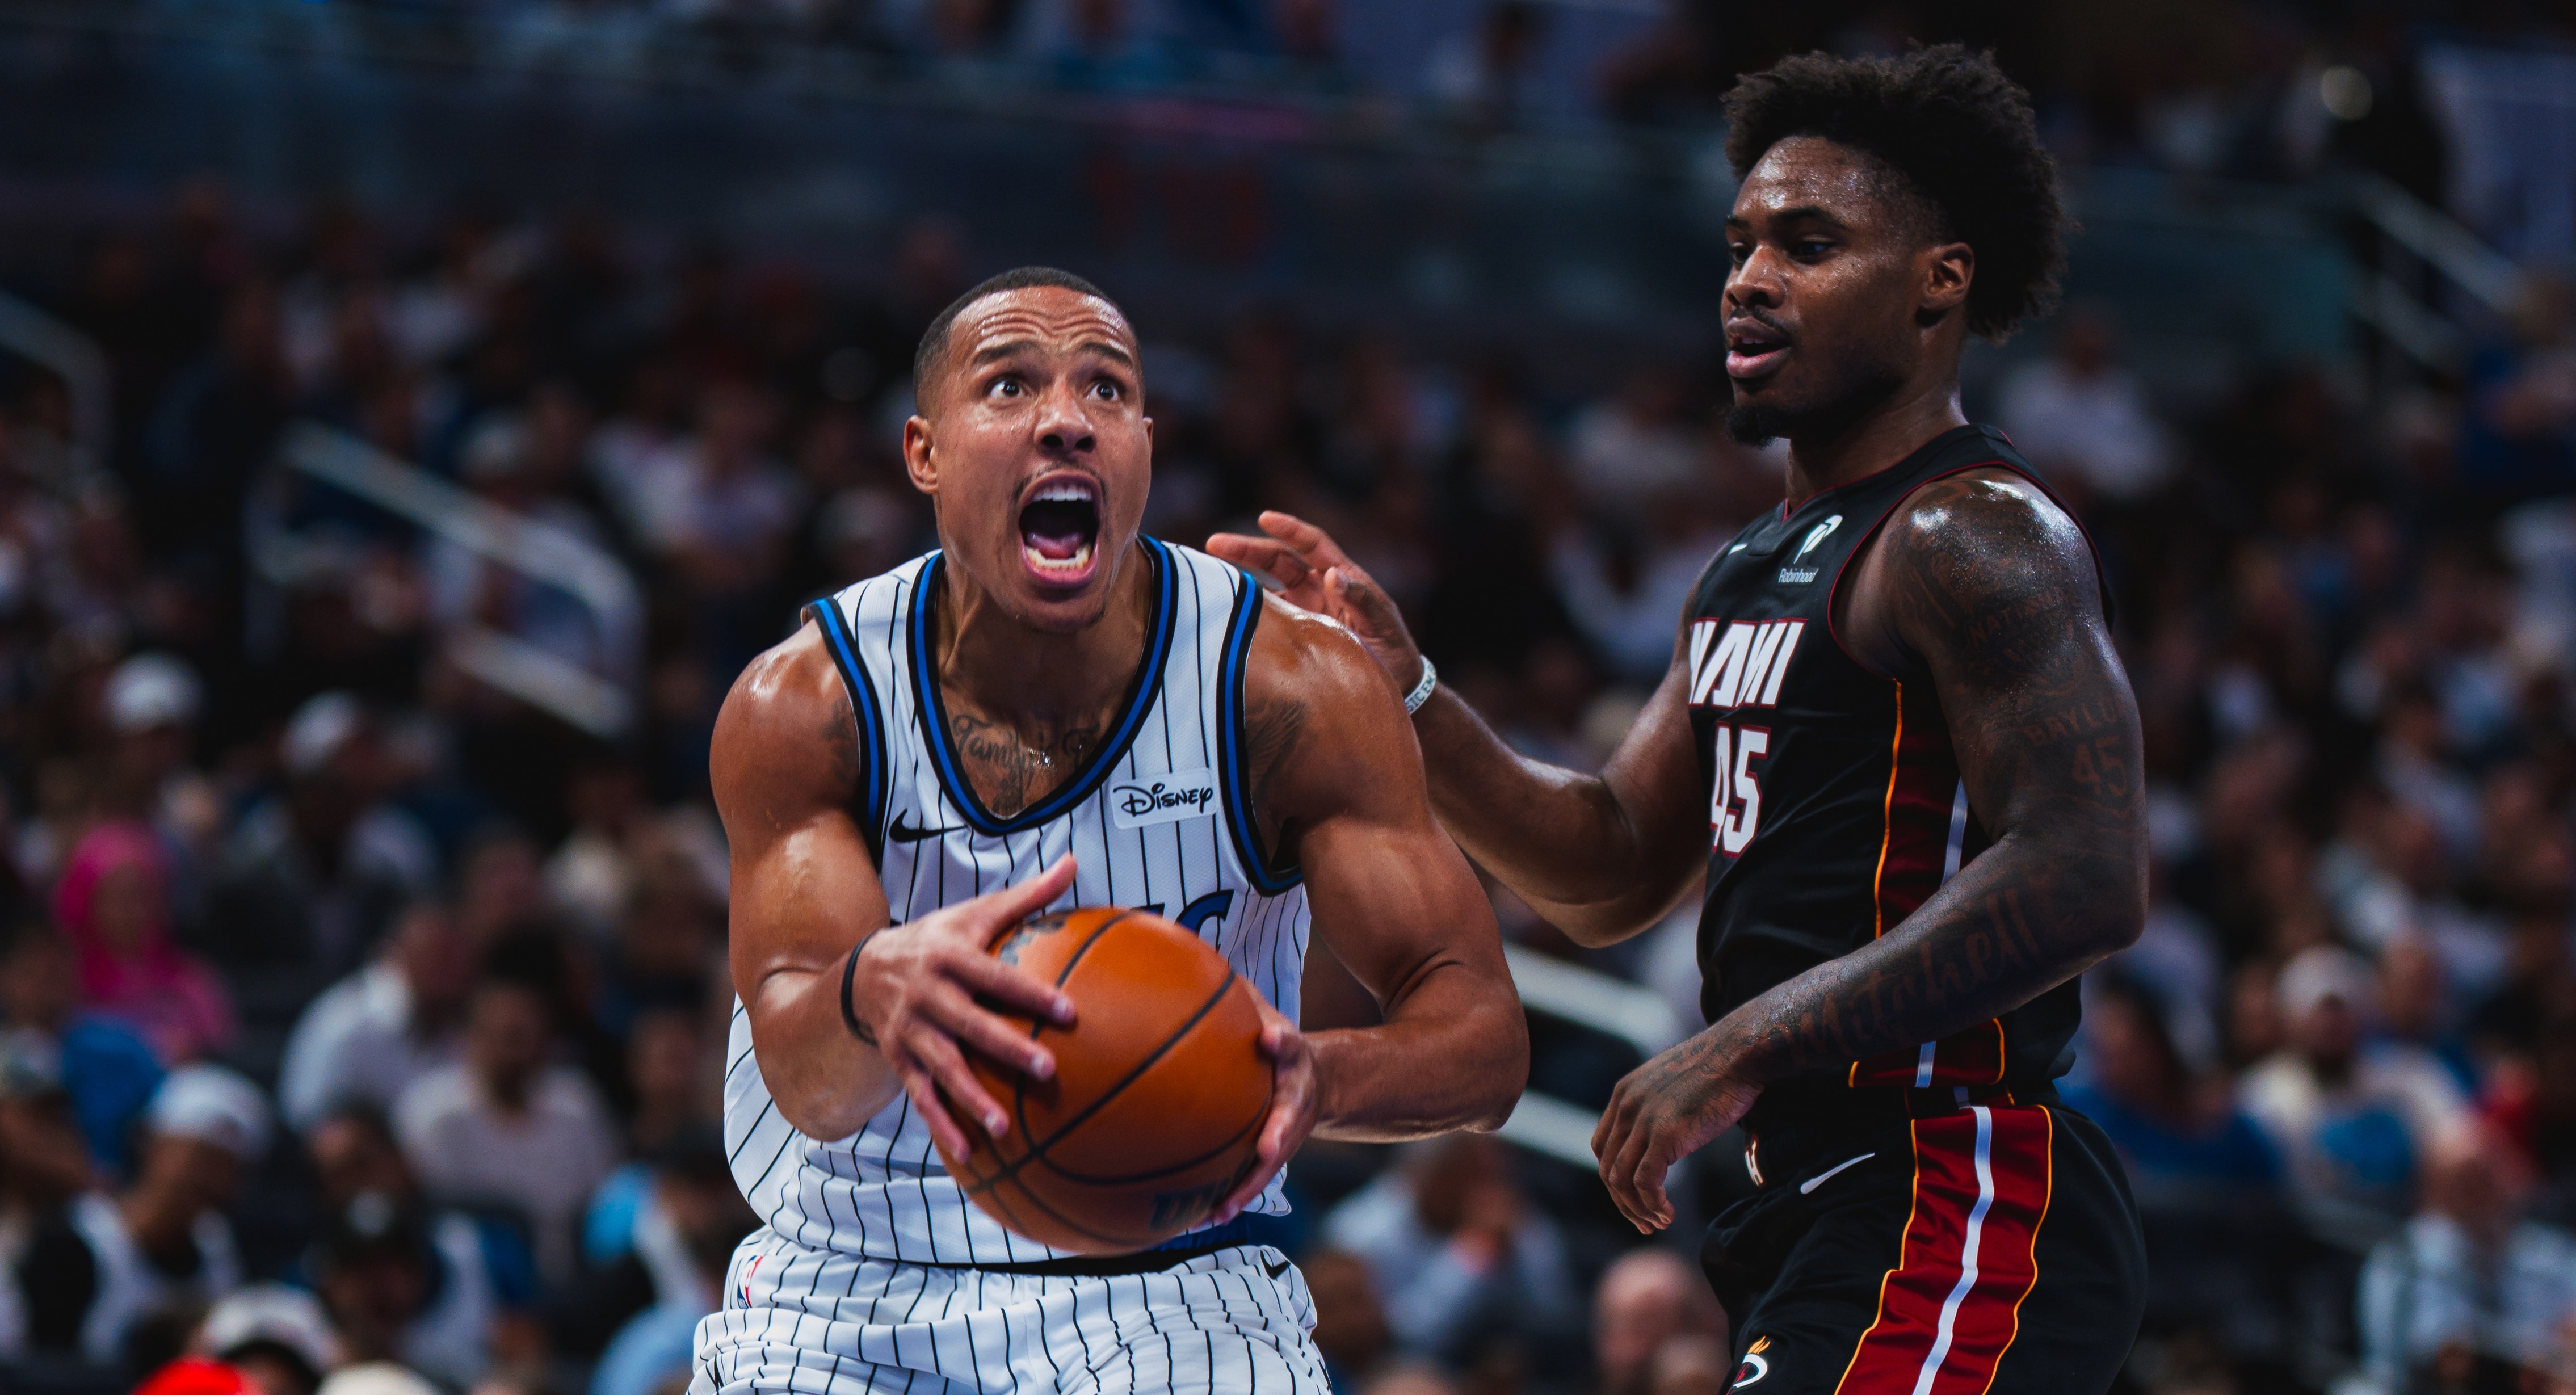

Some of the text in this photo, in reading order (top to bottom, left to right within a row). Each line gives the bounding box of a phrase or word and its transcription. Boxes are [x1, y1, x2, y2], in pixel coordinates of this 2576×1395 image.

[1777, 568, 1818, 583] Robinhood
[1709, 721, 1771, 859] 45
[2072, 733, 2130, 798] 45
